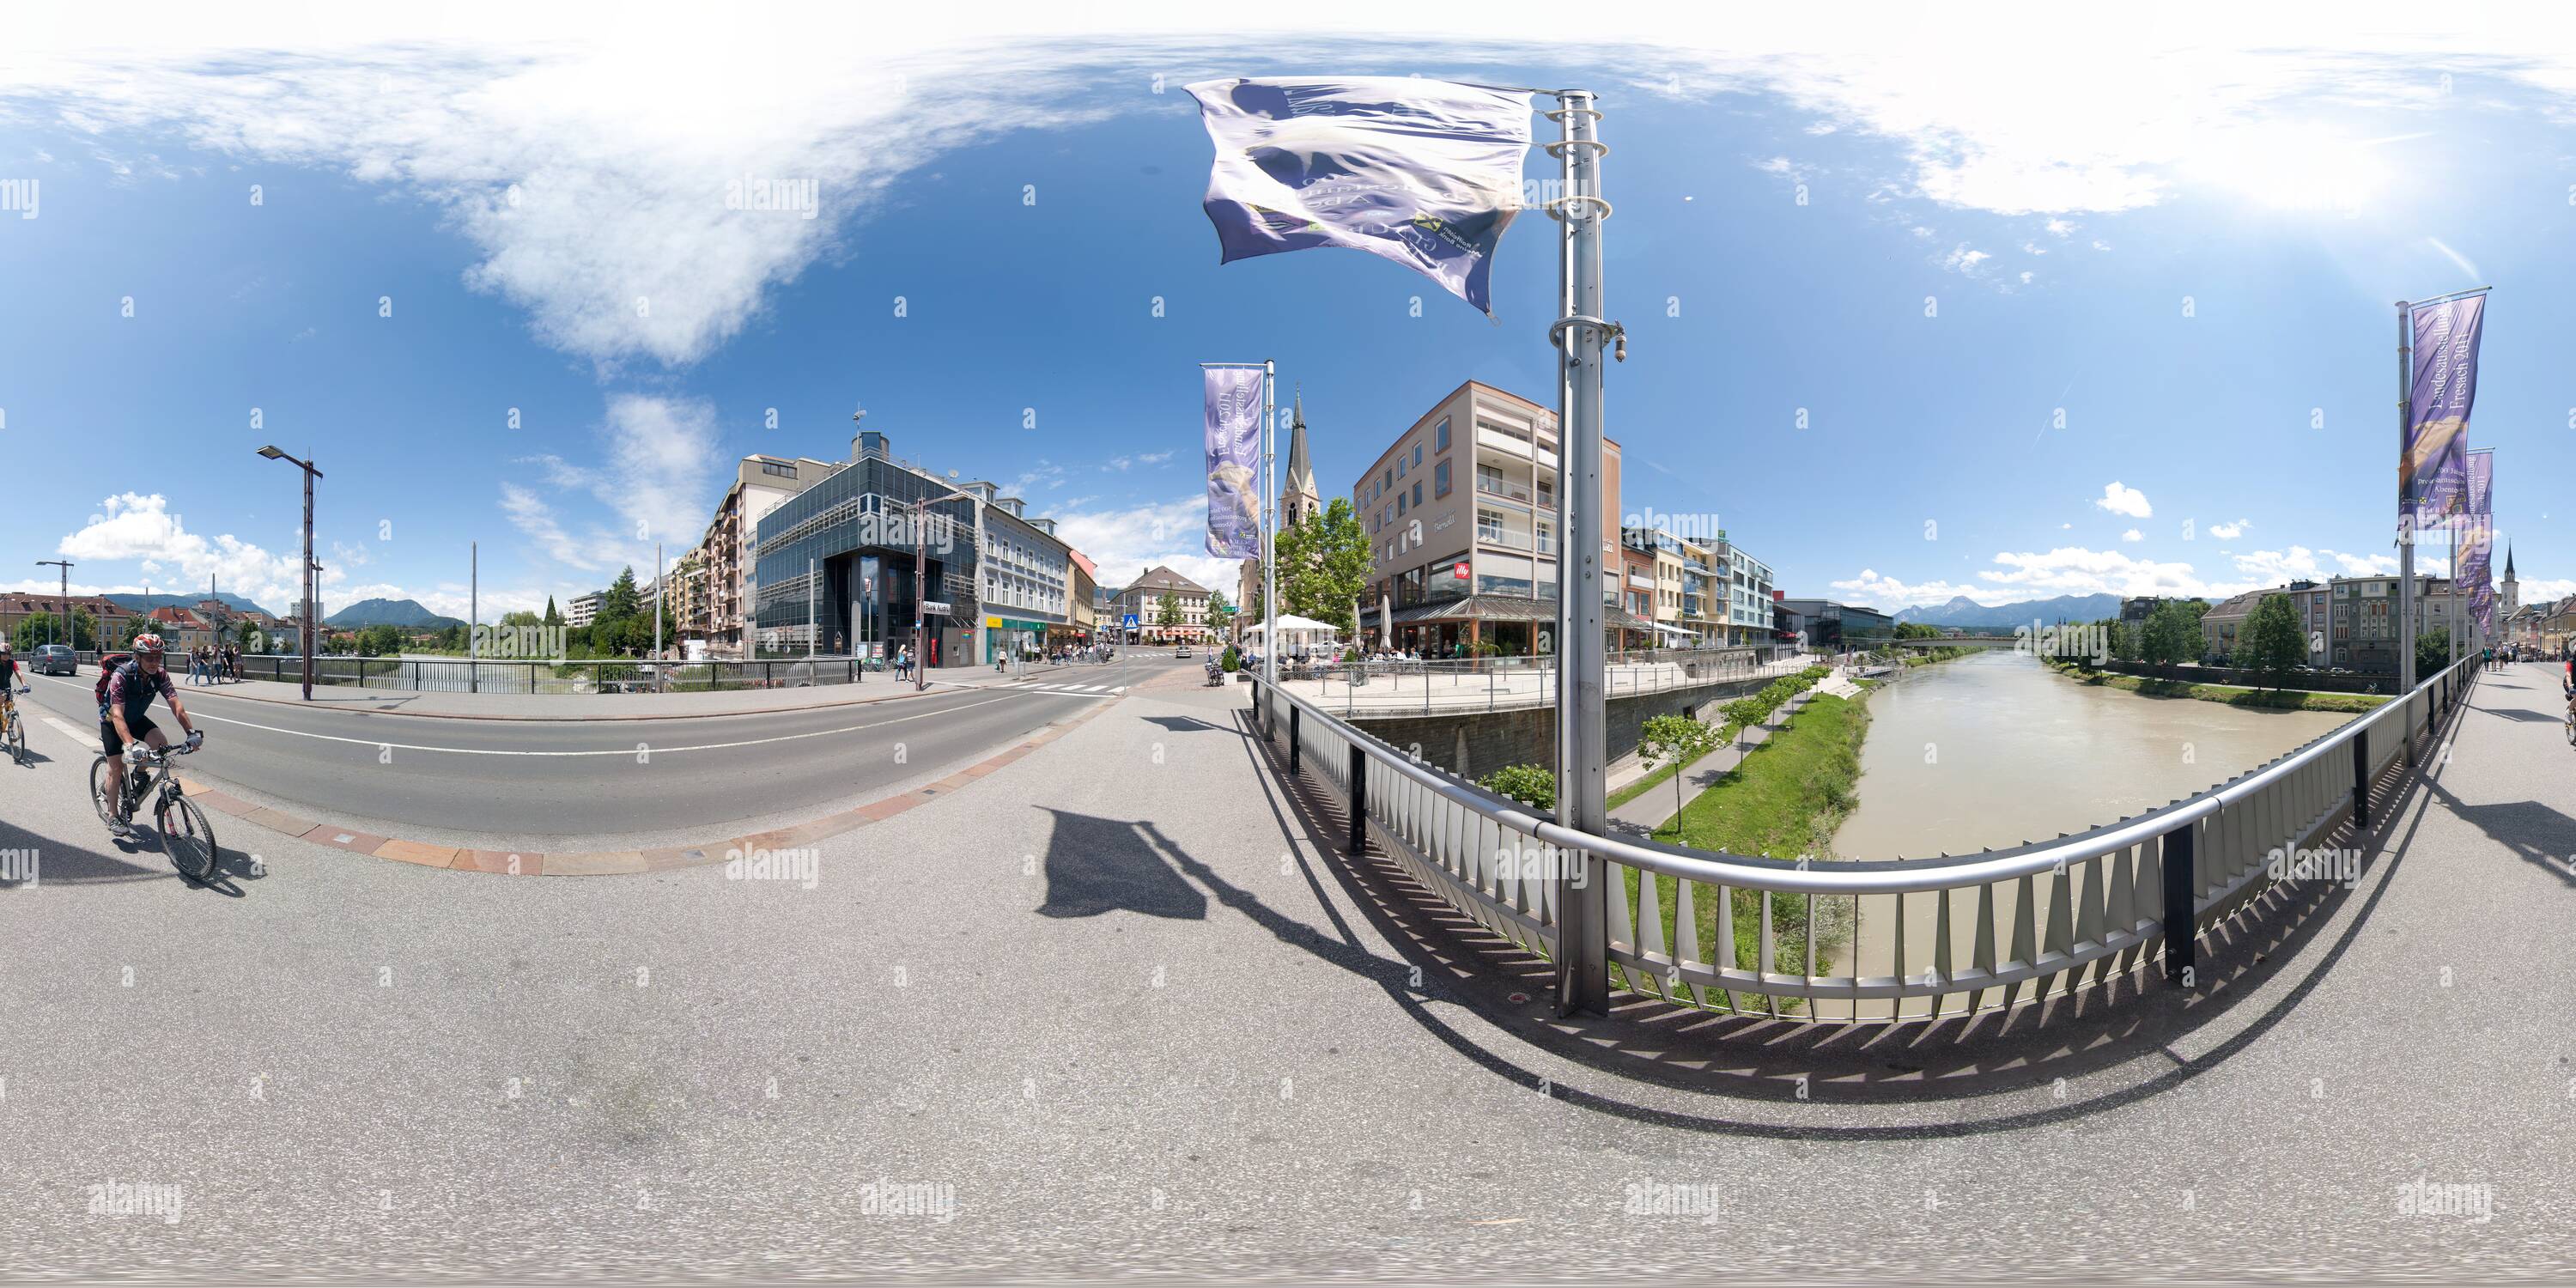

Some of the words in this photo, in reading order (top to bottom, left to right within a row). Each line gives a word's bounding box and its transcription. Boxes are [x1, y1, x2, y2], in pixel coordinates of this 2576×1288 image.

[2429, 304, 2451, 409] Landesausstellung
[2455, 332, 2470, 359] 2011
[2450, 361, 2468, 409] Fresach
[1455, 565, 1469, 577] illy
